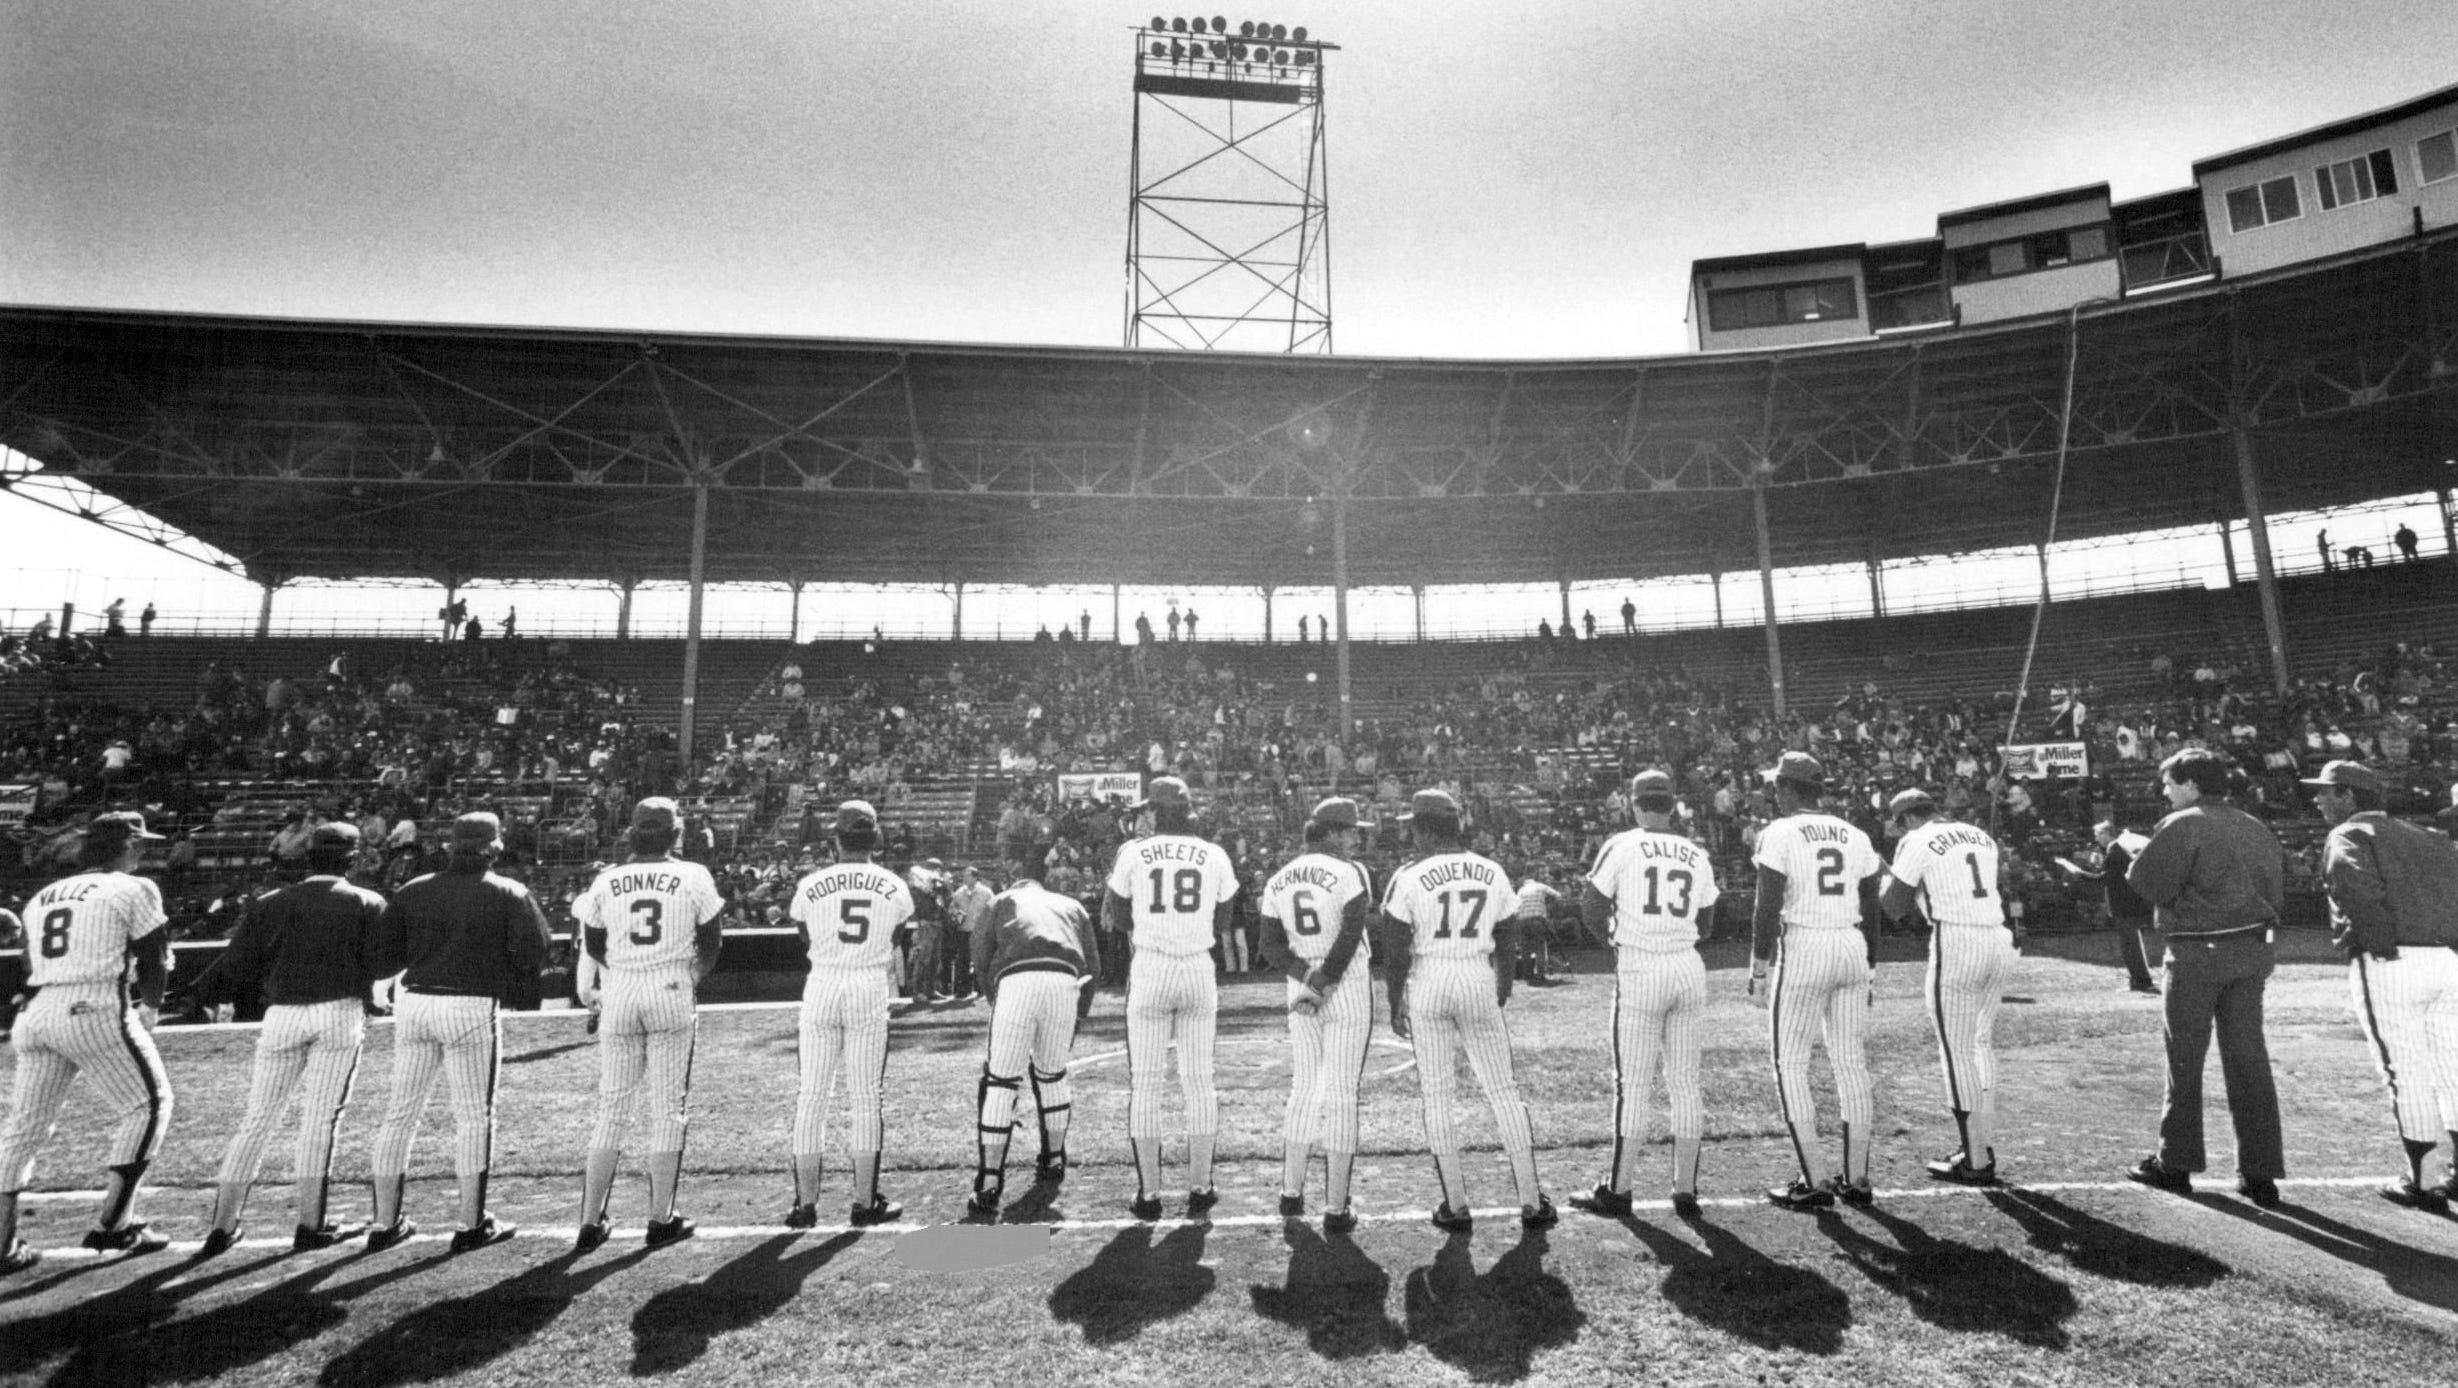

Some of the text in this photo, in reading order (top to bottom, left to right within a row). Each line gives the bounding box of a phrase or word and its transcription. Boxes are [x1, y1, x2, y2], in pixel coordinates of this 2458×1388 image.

[2045, 746, 2084, 760] Miller
[2047, 762, 2080, 775] me
[1103, 777, 1138, 790] Miller
[1799, 824, 1848, 844] YOUNG
[1928, 829, 1992, 856] GRANGER
[1140, 843, 1208, 866] SHEETS
[1640, 840, 1700, 868] CALISE
[610, 872, 681, 897] BONNER
[1272, 866, 1338, 895] HERNANDEZ
[1419, 861, 1495, 892] OQUENDO
[1817, 847, 1845, 896] 2
[1965, 852, 1988, 898] 1
[40, 883, 99, 907] VALLE
[805, 872, 898, 903] RODRIGUEZ
[1149, 868, 1202, 913] 18
[1643, 866, 1693, 918] 13
[630, 898, 662, 946] 3
[838, 899, 872, 944] 5
[1293, 890, 1321, 936] 6
[1434, 889, 1487, 938] 17
[41, 907, 73, 959] 8
